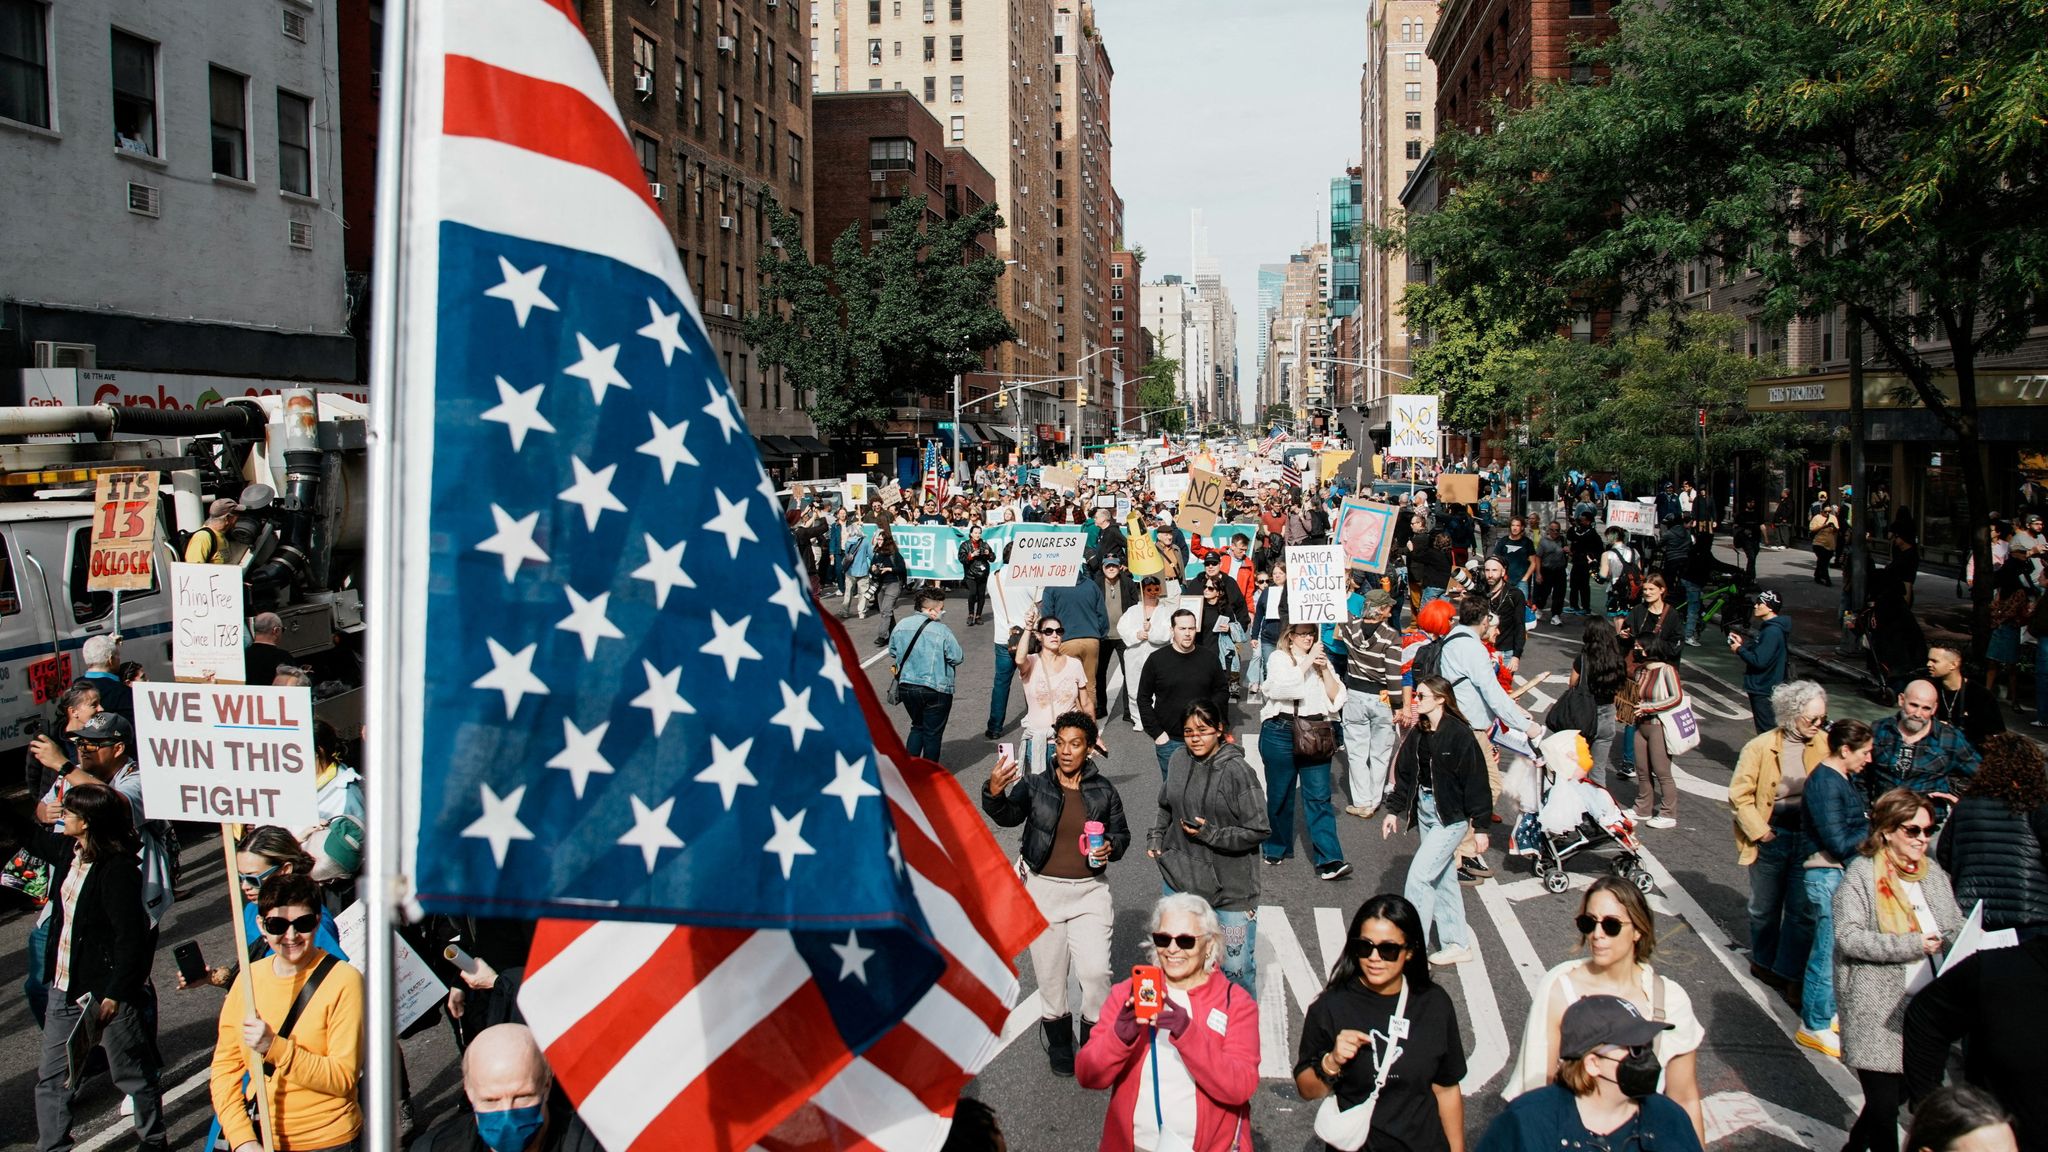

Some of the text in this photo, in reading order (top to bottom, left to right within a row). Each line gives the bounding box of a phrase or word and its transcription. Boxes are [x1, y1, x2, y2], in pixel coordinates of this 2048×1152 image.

[103, 373, 117, 381] AVE
[1767, 384, 1825, 402] THE VERMEER
[1398, 404, 1431, 426] NO
[1393, 429, 1435, 446] KINGS
[1187, 477, 1219, 507] NO
[98, 501, 150, 540] 13
[1018, 537, 1077, 549] CONGRESS
[1127, 535, 1152, 551] TOP
[91, 549, 150, 577] O'CLOCK
[900, 548, 932, 567] FF!
[1127, 547, 1154, 561] ING
[1290, 551, 1333, 564] AMERICA
[1011, 564, 1076, 579] DAMN JOB!!
[208, 573, 233, 609] Free
[1291, 575, 1344, 591] FASCIST
[1302, 593, 1332, 604] SINCE
[1299, 603, 1336, 621] 1776
[179, 618, 240, 649] Since 1783
[34, 655, 70, 677] FIGT
[148, 690, 299, 727] WE WILL
[1680, 713, 1691, 721] WE
[1682, 719, 1694, 727] ARE
[149, 737, 304, 774] WIN THIS
[180, 784, 281, 818] FIGHT
